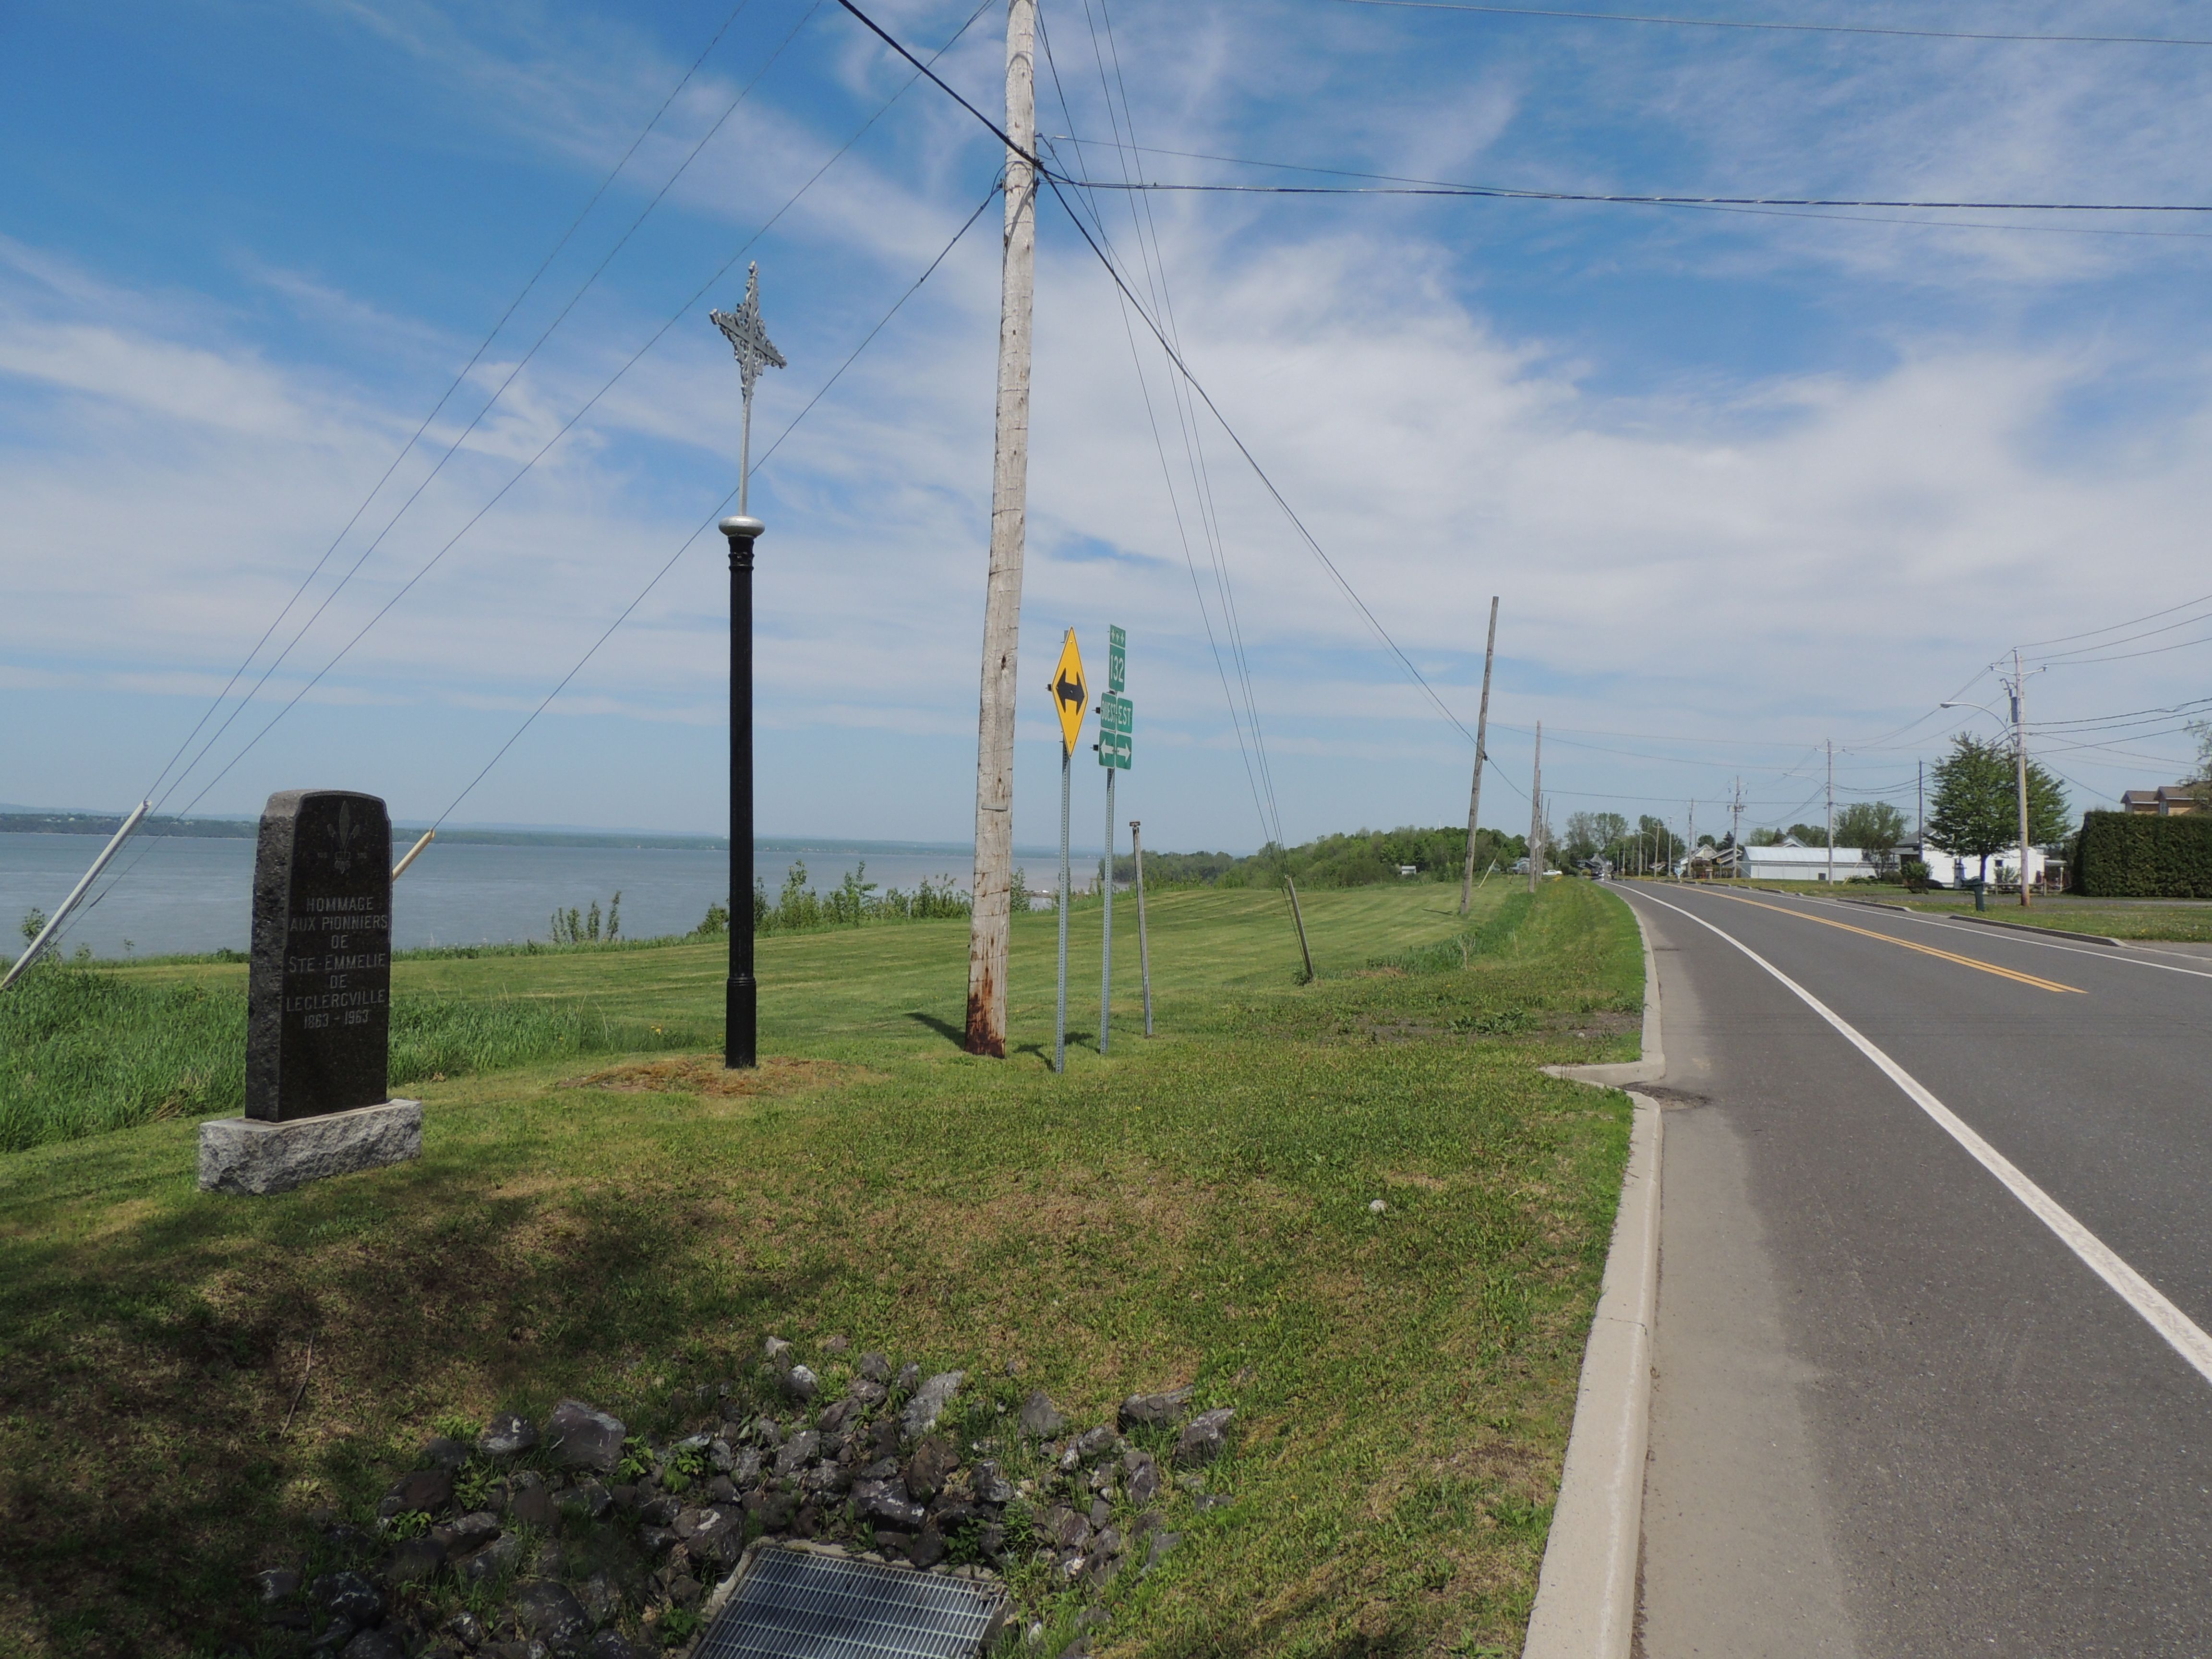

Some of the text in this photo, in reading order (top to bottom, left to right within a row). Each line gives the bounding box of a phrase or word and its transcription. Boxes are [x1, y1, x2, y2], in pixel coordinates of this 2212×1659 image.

[1110, 654, 1124, 683] 132
[1101, 700, 1116, 723] OUEST
[1118, 705, 1131, 726] EST
[307, 897, 374, 912] HOMMAGE
[290, 914, 388, 931] AUX PIONNIERS
[331, 935, 349, 949] DE
[330, 974, 348, 989] DE
[287, 989, 385, 1012] LECLERCVILLE
[304, 1013, 329, 1029] 1863
[345, 1010, 369, 1025] 1963
